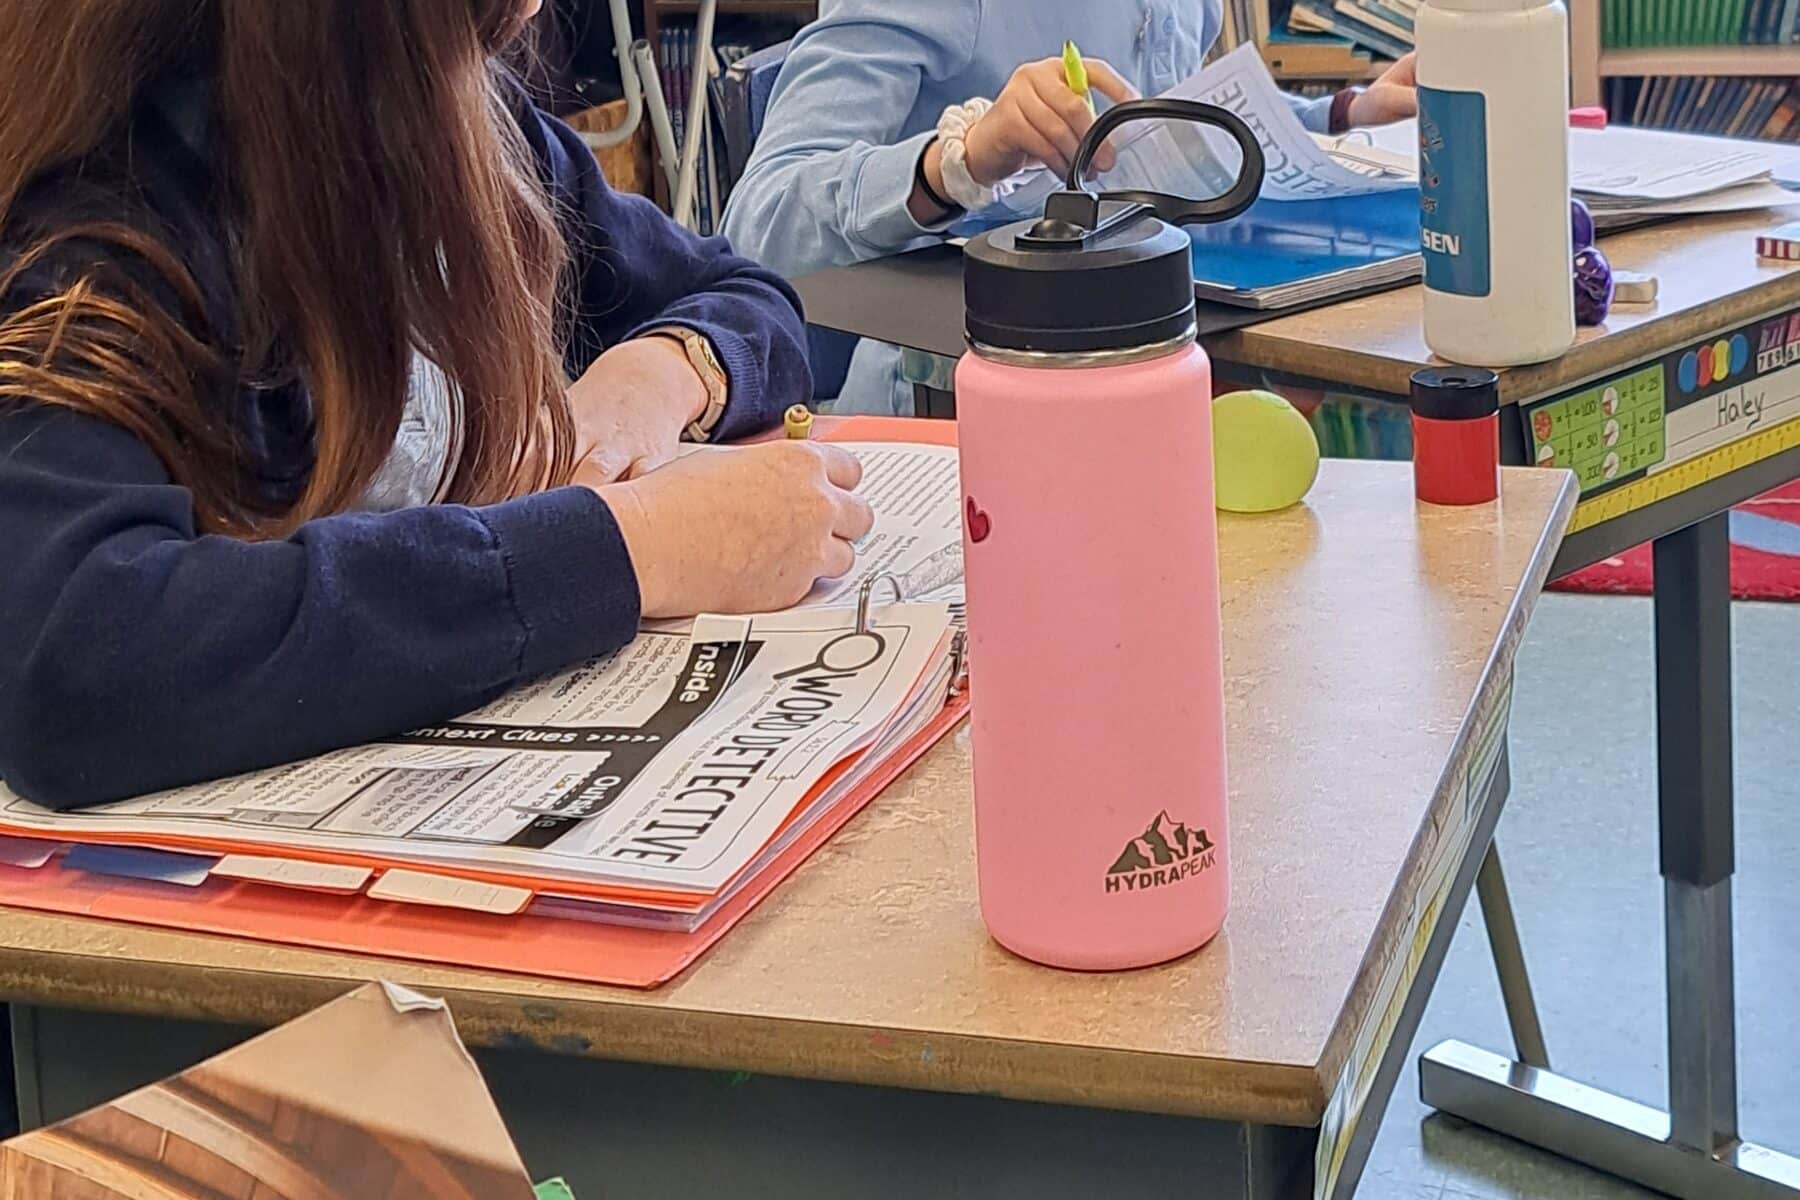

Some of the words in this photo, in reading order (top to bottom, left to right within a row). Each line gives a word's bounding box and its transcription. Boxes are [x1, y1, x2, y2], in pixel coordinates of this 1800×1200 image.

[1717, 386, 1766, 431] Haley
[679, 645, 720, 702] nside
[752, 673, 858, 732] WORD
[502, 729, 578, 743] Clues
[612, 735, 791, 864] DETECTIVE
[1105, 849, 1216, 893] HYDRAPEAK
